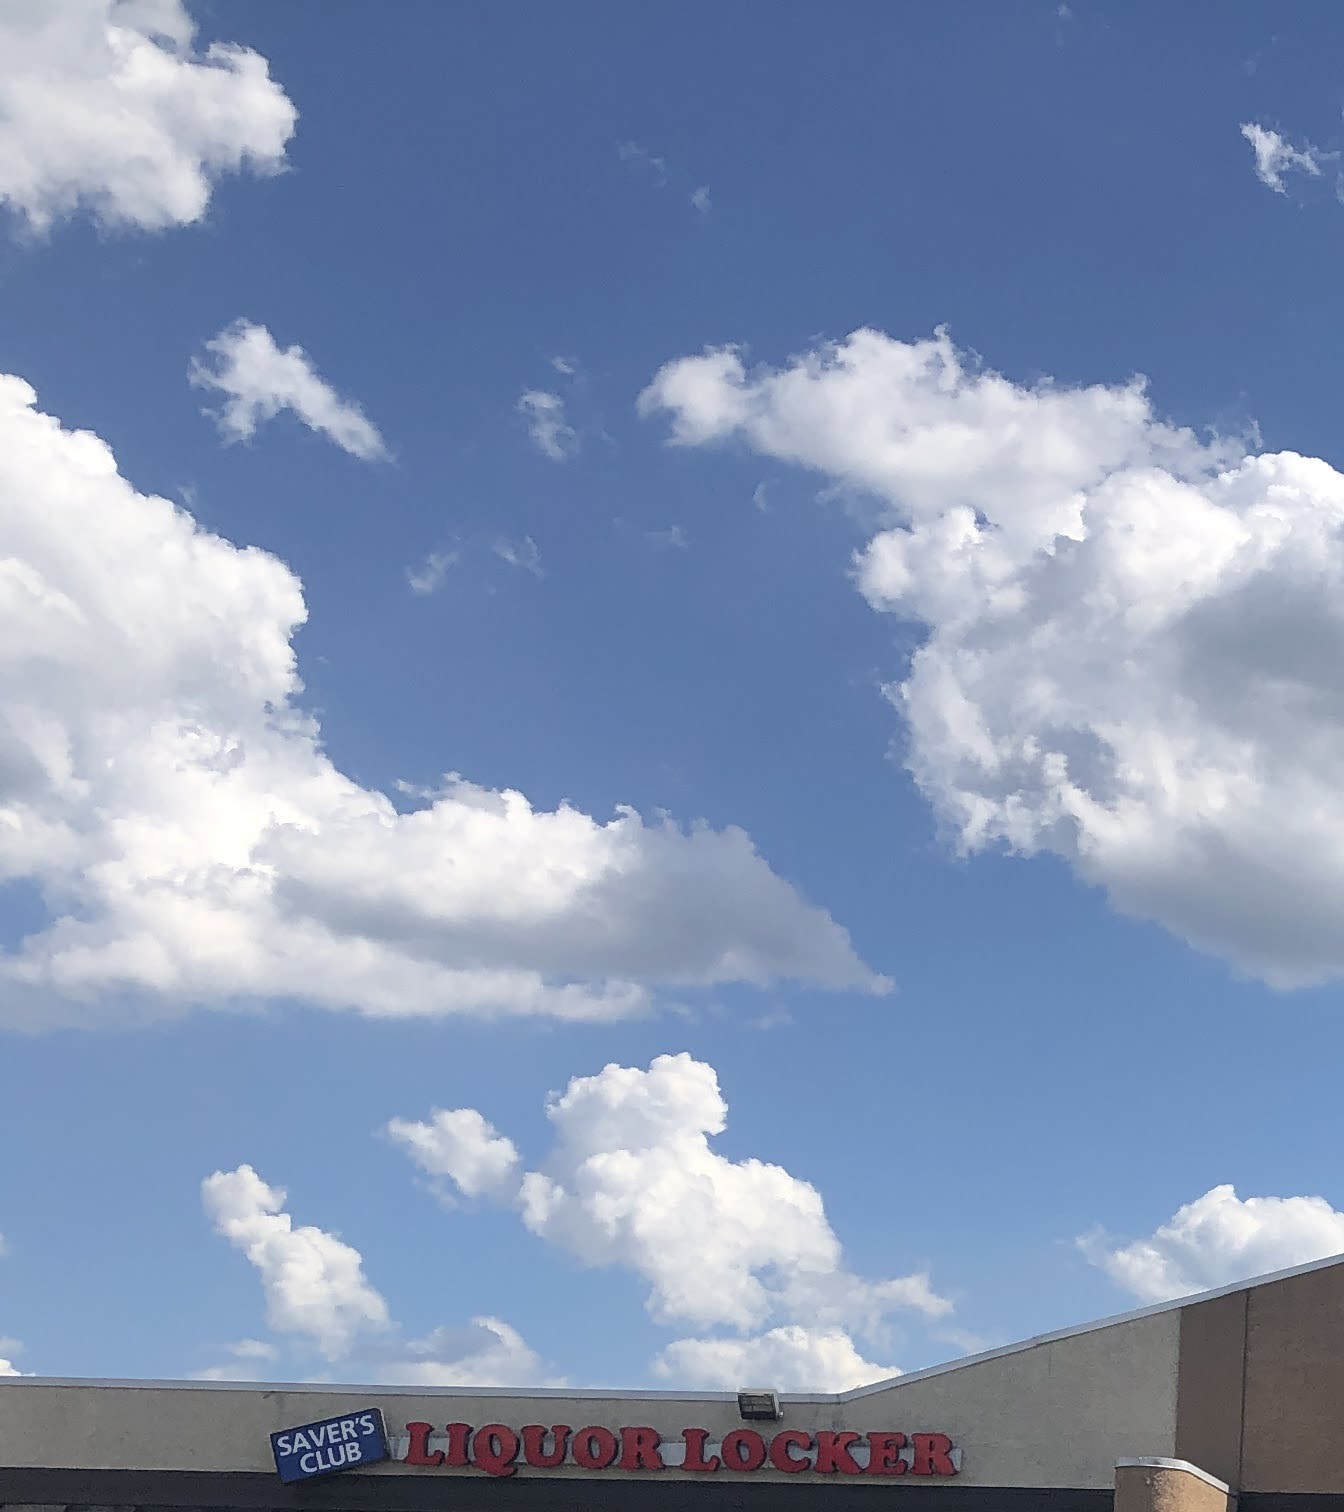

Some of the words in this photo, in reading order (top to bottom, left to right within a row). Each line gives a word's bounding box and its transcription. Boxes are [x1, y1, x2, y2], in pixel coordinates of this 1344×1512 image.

[277, 1413, 376, 1458] SAVER'S
[299, 1440, 363, 1475] CLUB
[403, 1421, 666, 1477] LIQUOR
[680, 1427, 960, 1477] LOCKER
